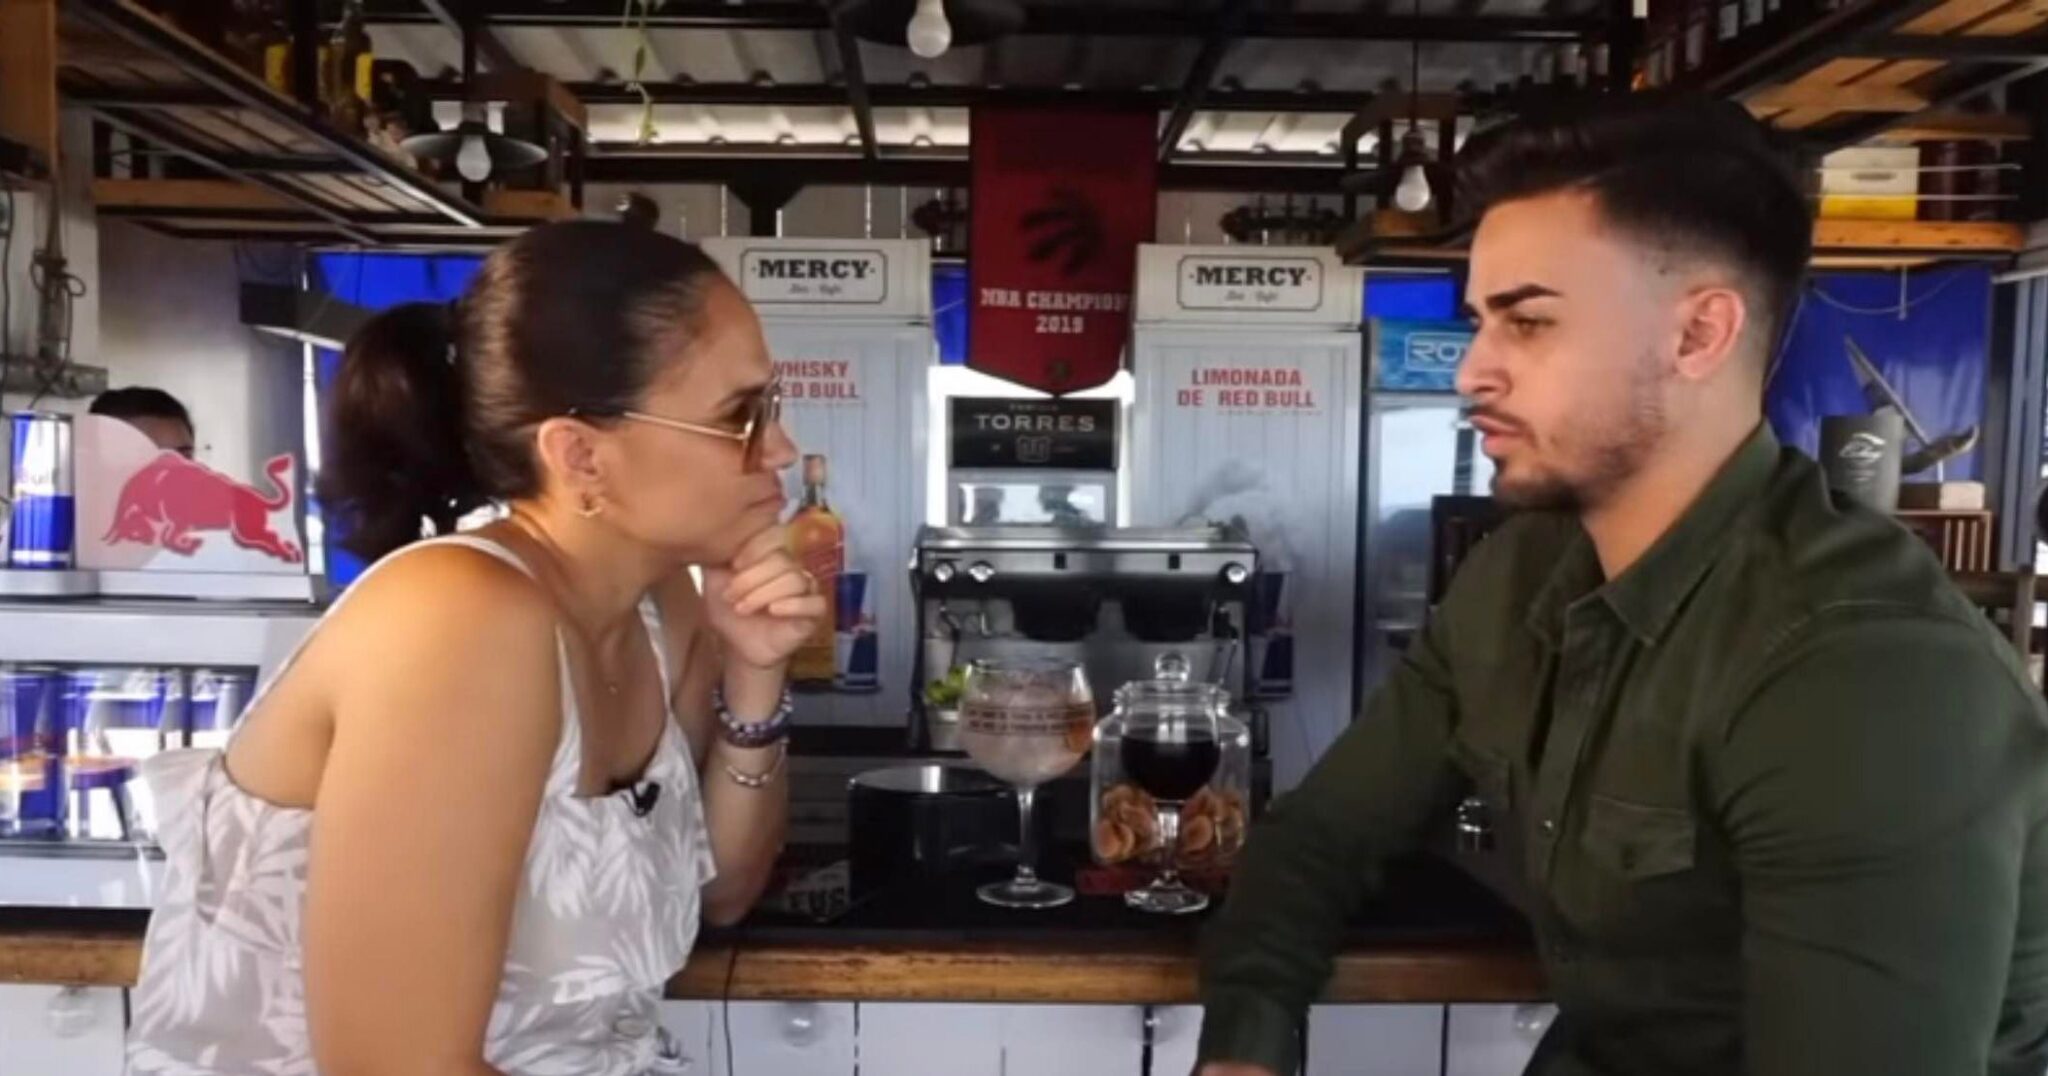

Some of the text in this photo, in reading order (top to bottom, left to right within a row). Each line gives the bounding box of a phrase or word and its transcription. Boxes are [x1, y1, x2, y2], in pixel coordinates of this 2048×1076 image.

[758, 259, 870, 279] MERCY
[1195, 266, 1307, 287] MERCY
[980, 288, 1021, 308] NBA
[1034, 315, 1085, 334] 2019
[1191, 368, 1302, 386] LIMONADA
[809, 381, 860, 399] BULL
[1177, 389, 1315, 408] DE RED BULL
[973, 413, 1096, 432] TORRES
